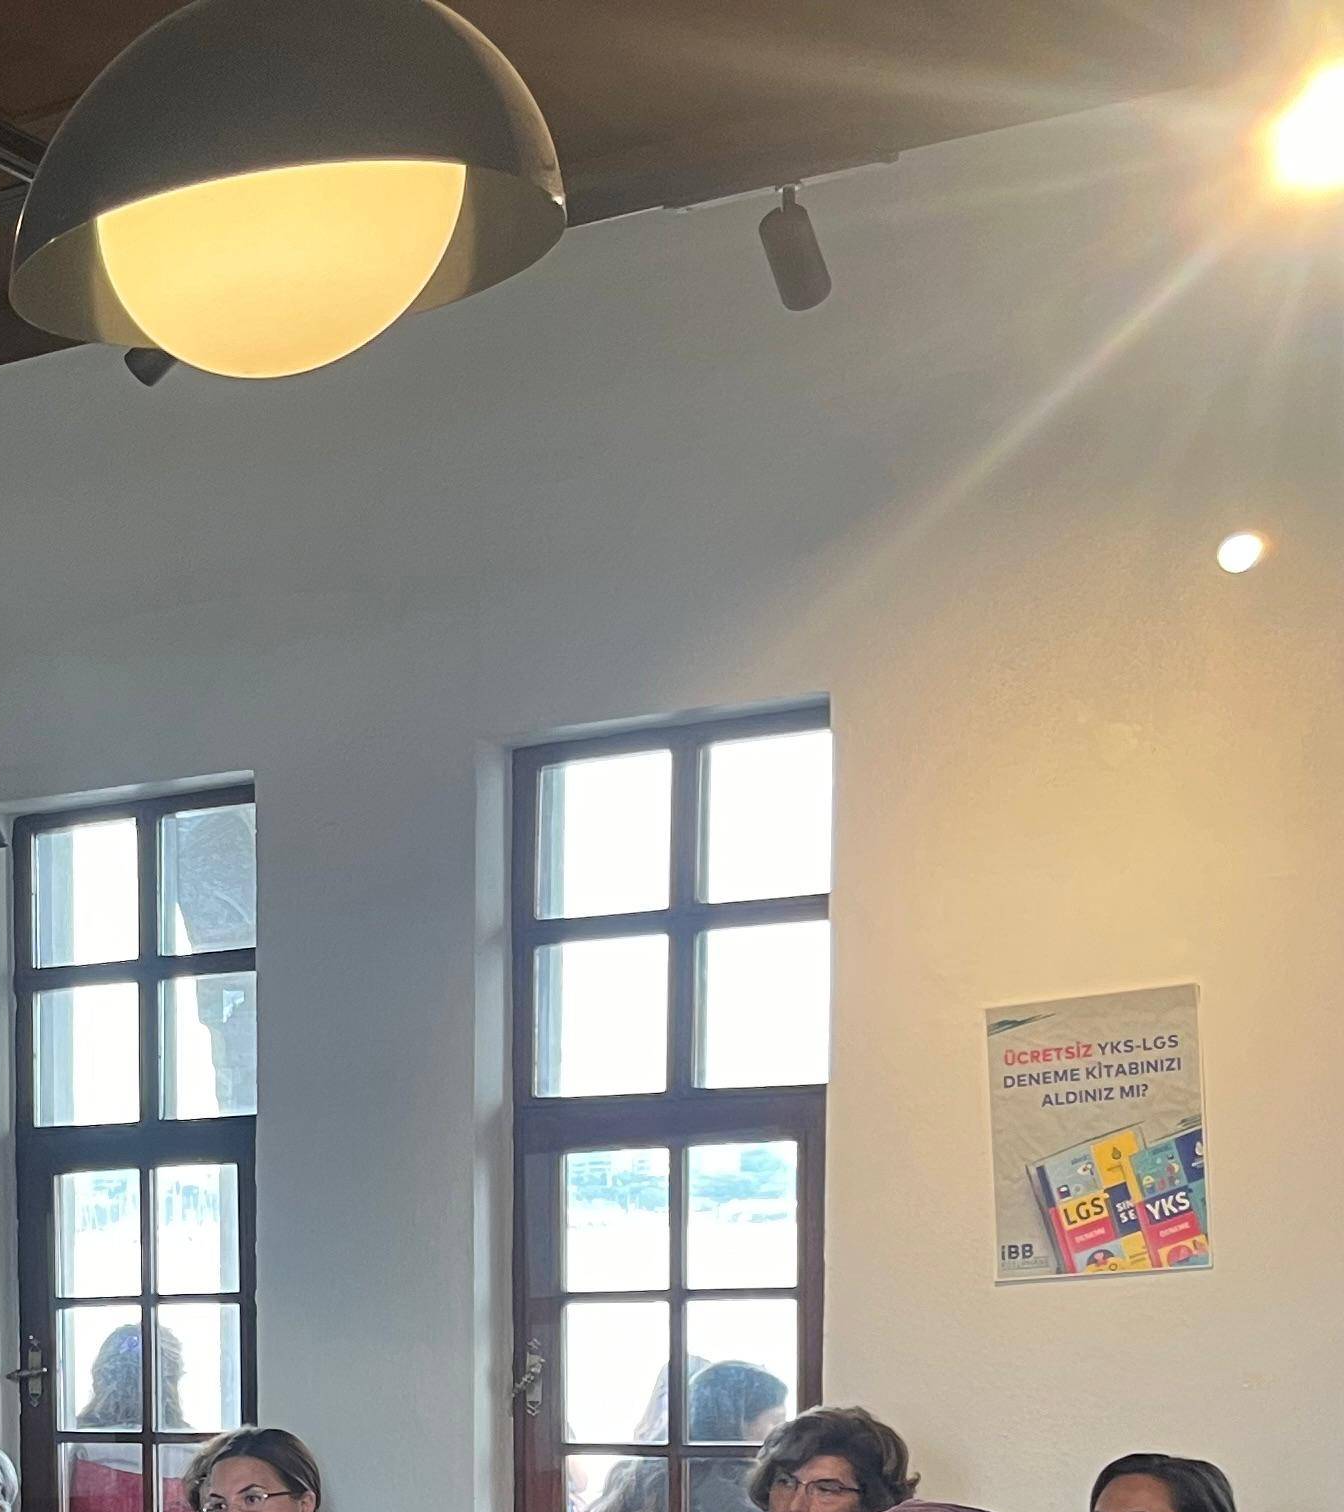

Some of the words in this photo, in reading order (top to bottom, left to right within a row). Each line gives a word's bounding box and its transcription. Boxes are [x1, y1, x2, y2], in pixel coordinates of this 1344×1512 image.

[1003, 1041, 1092, 1065] ÜCRETSİZ
[1098, 1034, 1179, 1056] YKS-LGS
[1003, 1068, 1080, 1089] DENEME
[1085, 1057, 1182, 1080] KİTABINIZI
[1041, 1087, 1114, 1107] ALDINIZ
[1120, 1083, 1149, 1099] MI?
[1063, 1197, 1105, 1225] LGS
[1145, 1191, 1190, 1220] YKS
